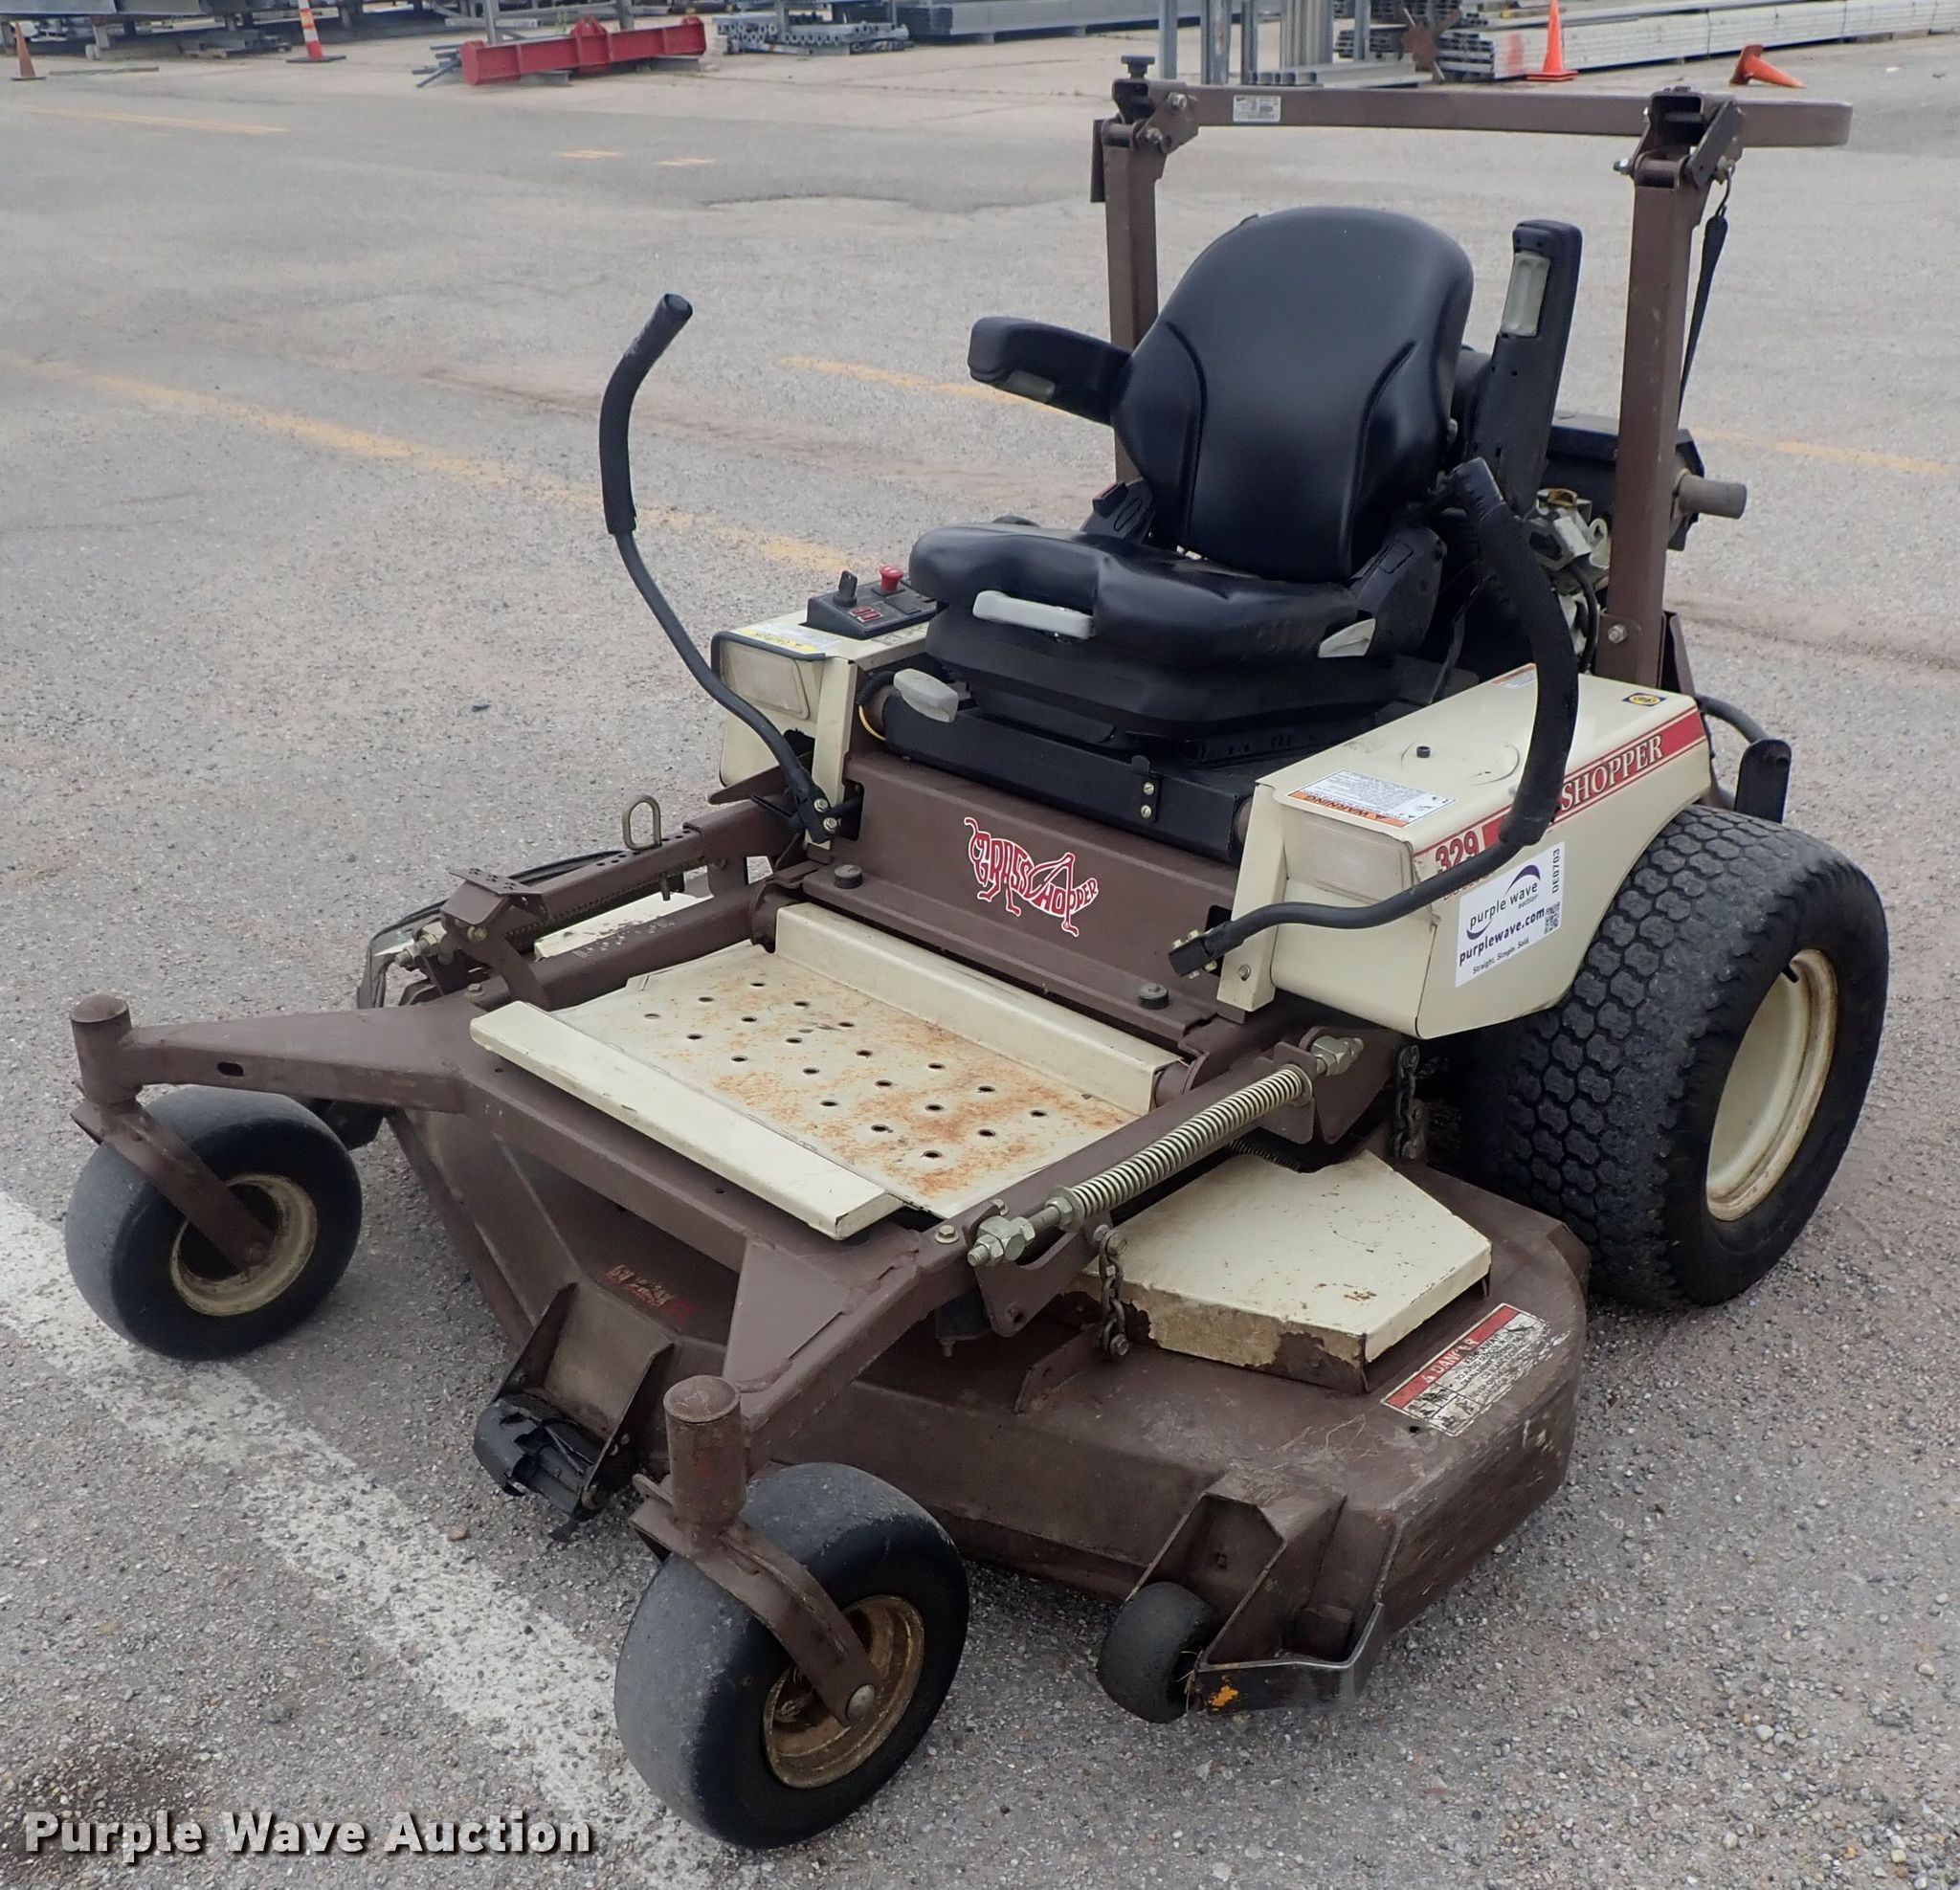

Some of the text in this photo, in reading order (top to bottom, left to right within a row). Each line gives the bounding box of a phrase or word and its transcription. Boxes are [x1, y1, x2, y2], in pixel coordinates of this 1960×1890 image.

[1304, 794, 1370, 817] WARNING
[1436, 831, 1479, 874] 329
[1470, 899, 1507, 931] purple
[1509, 881, 1538, 905] wave
[1459, 907, 1545, 967] purplewave.com
